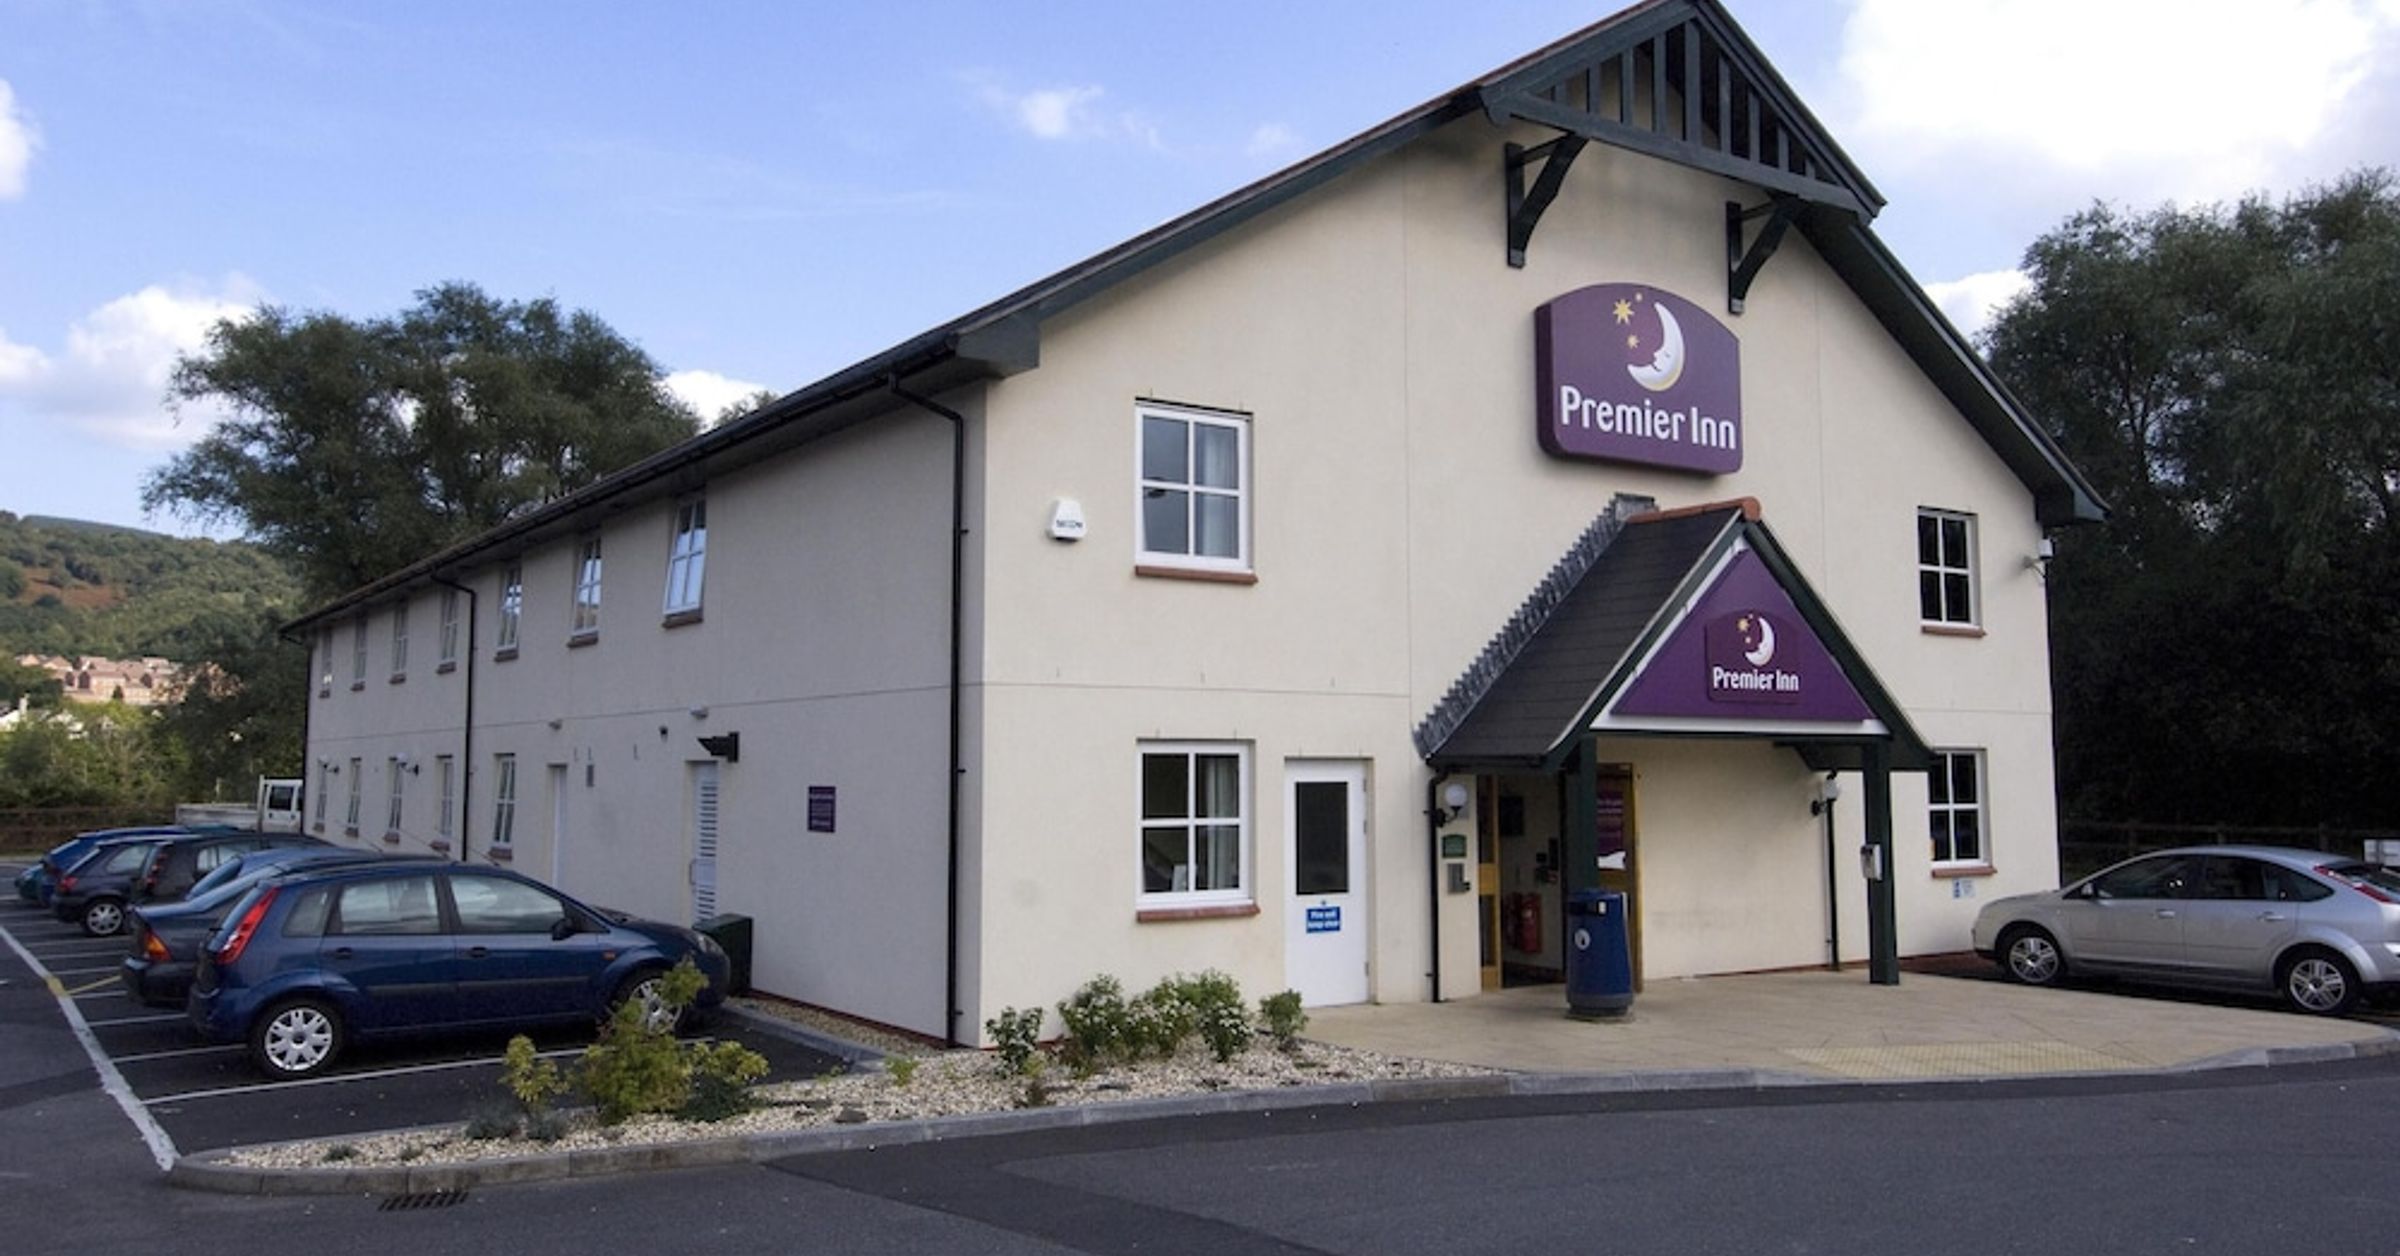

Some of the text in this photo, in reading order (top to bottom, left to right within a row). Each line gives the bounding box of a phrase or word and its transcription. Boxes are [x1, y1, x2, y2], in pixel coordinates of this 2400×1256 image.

[1561, 385, 1736, 449] Premier Inn
[1713, 666, 1799, 691] Premier Inn
